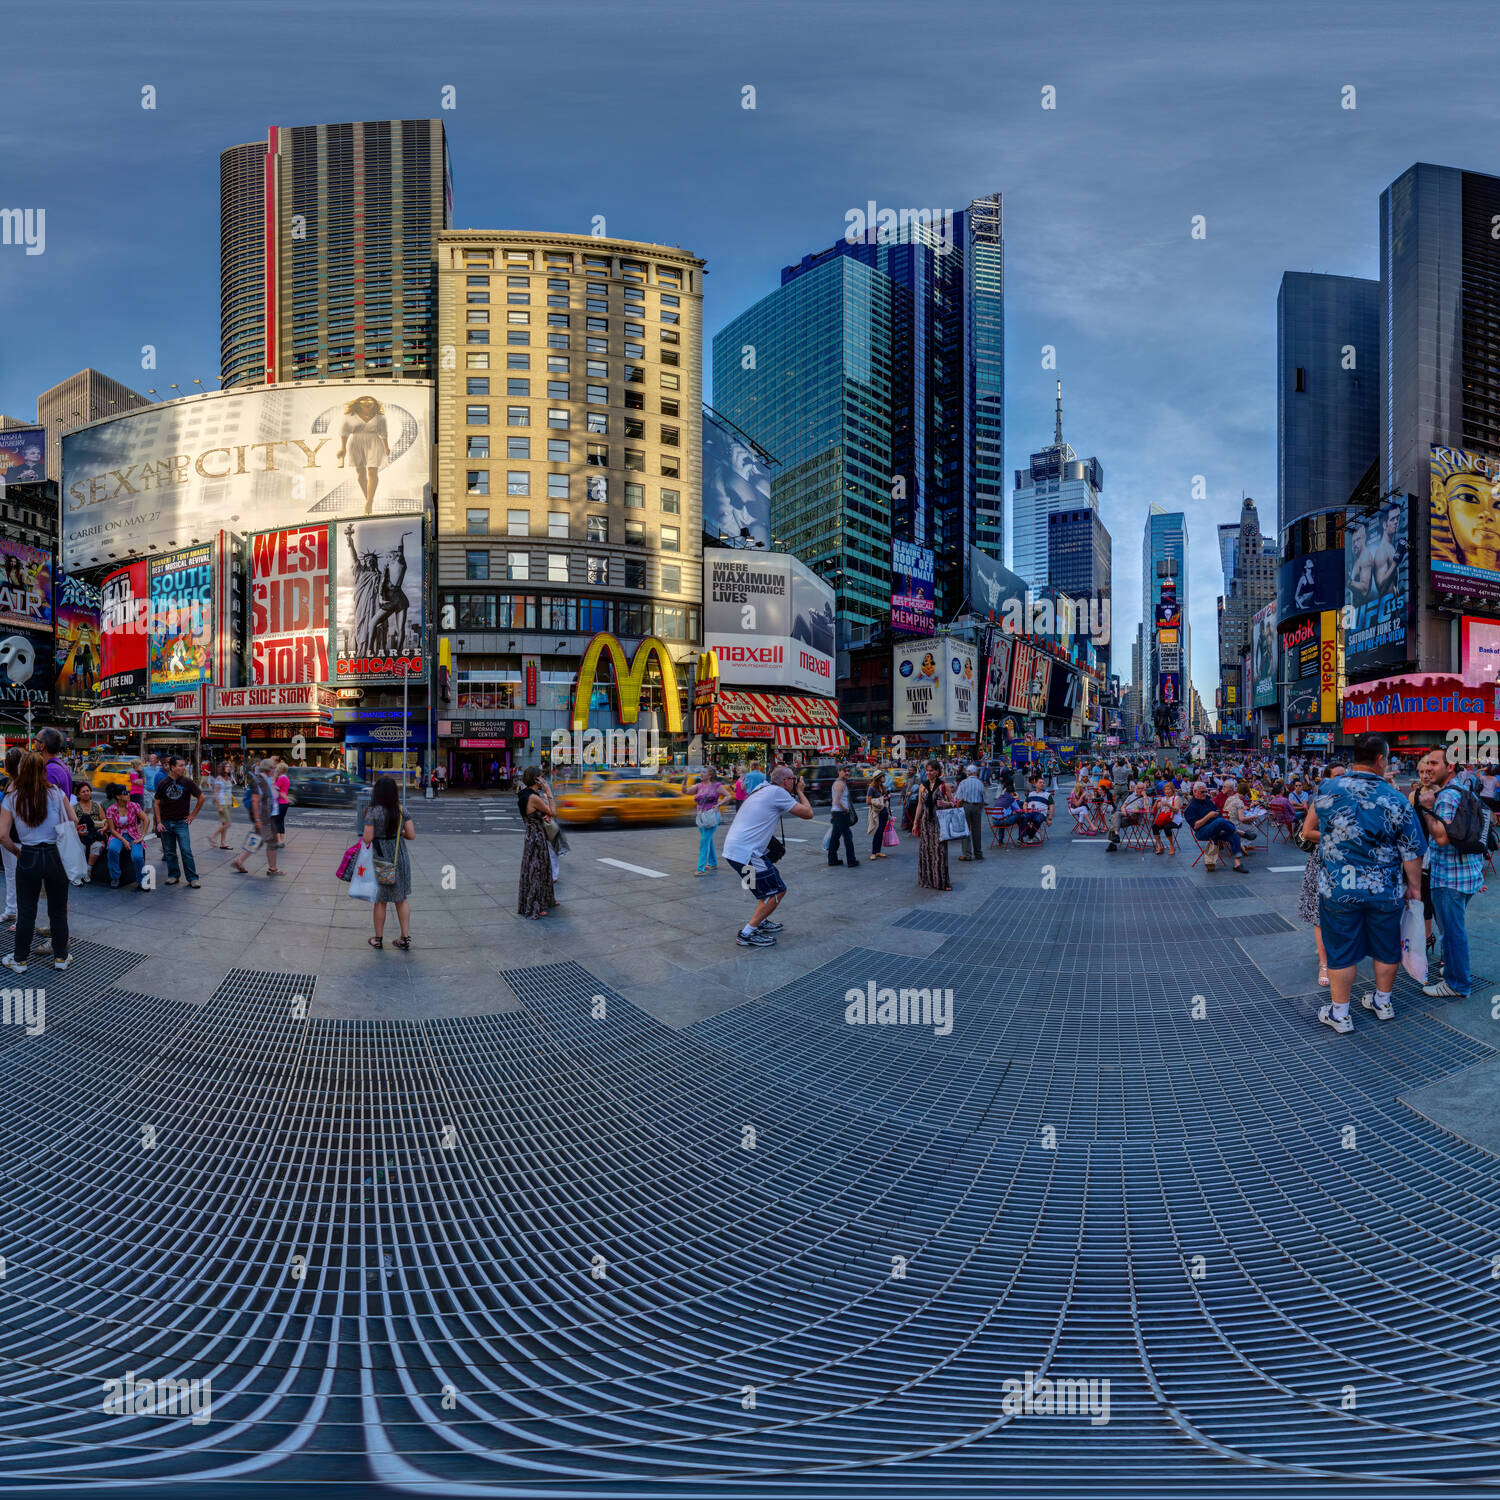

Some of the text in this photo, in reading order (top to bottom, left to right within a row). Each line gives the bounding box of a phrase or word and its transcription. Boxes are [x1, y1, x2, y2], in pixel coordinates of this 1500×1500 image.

[1435, 447, 1488, 473] KING
[68, 438, 332, 512] SEX AND THE CITY
[69, 511, 161, 541] CARRIE ON MAY 27
[251, 524, 329, 580] WEST
[893, 543, 921, 560] BLOWING
[893, 551, 934, 573] ROOF OFF
[151, 554, 211, 575] BEST MUSICAL REVIVAL
[713, 561, 748, 572] WHERE
[892, 561, 934, 583] BROADWAY!
[151, 564, 211, 595] SOUTH
[712, 570, 785, 587] MAXIMUM
[712, 582, 785, 596] PERFORMANCE
[151, 585, 211, 615] PACIFIC
[251, 574, 329, 636] SIDE
[712, 590, 748, 604] LIVES
[891, 609, 935, 630] MEMPHIS
[1354, 593, 1404, 630] UFC 115
[1282, 618, 1315, 651] Kodak
[1348, 617, 1401, 646] SATURDAY JUNE 12
[1364, 627, 1406, 650] PAY-PER-VIEW
[252, 634, 329, 687] STORY
[338, 648, 422, 660] AT LARGE
[712, 644, 784, 664] maxell
[1479, 646, 1491, 654] Bank
[336, 656, 423, 676] CHICAGO
[799, 650, 831, 678] maxell
[1322, 639, 1335, 693] Kodak
[120, 674, 134, 686] END
[219, 686, 312, 708] WEST SIDE STORY
[339, 688, 361, 699] FUEL
[906, 687, 933, 702] MAMMA
[726, 703, 751, 713] FRIDAY'S
[1344, 691, 1485, 720] Bank of America
[82, 707, 172, 731] GUEST SUITES
